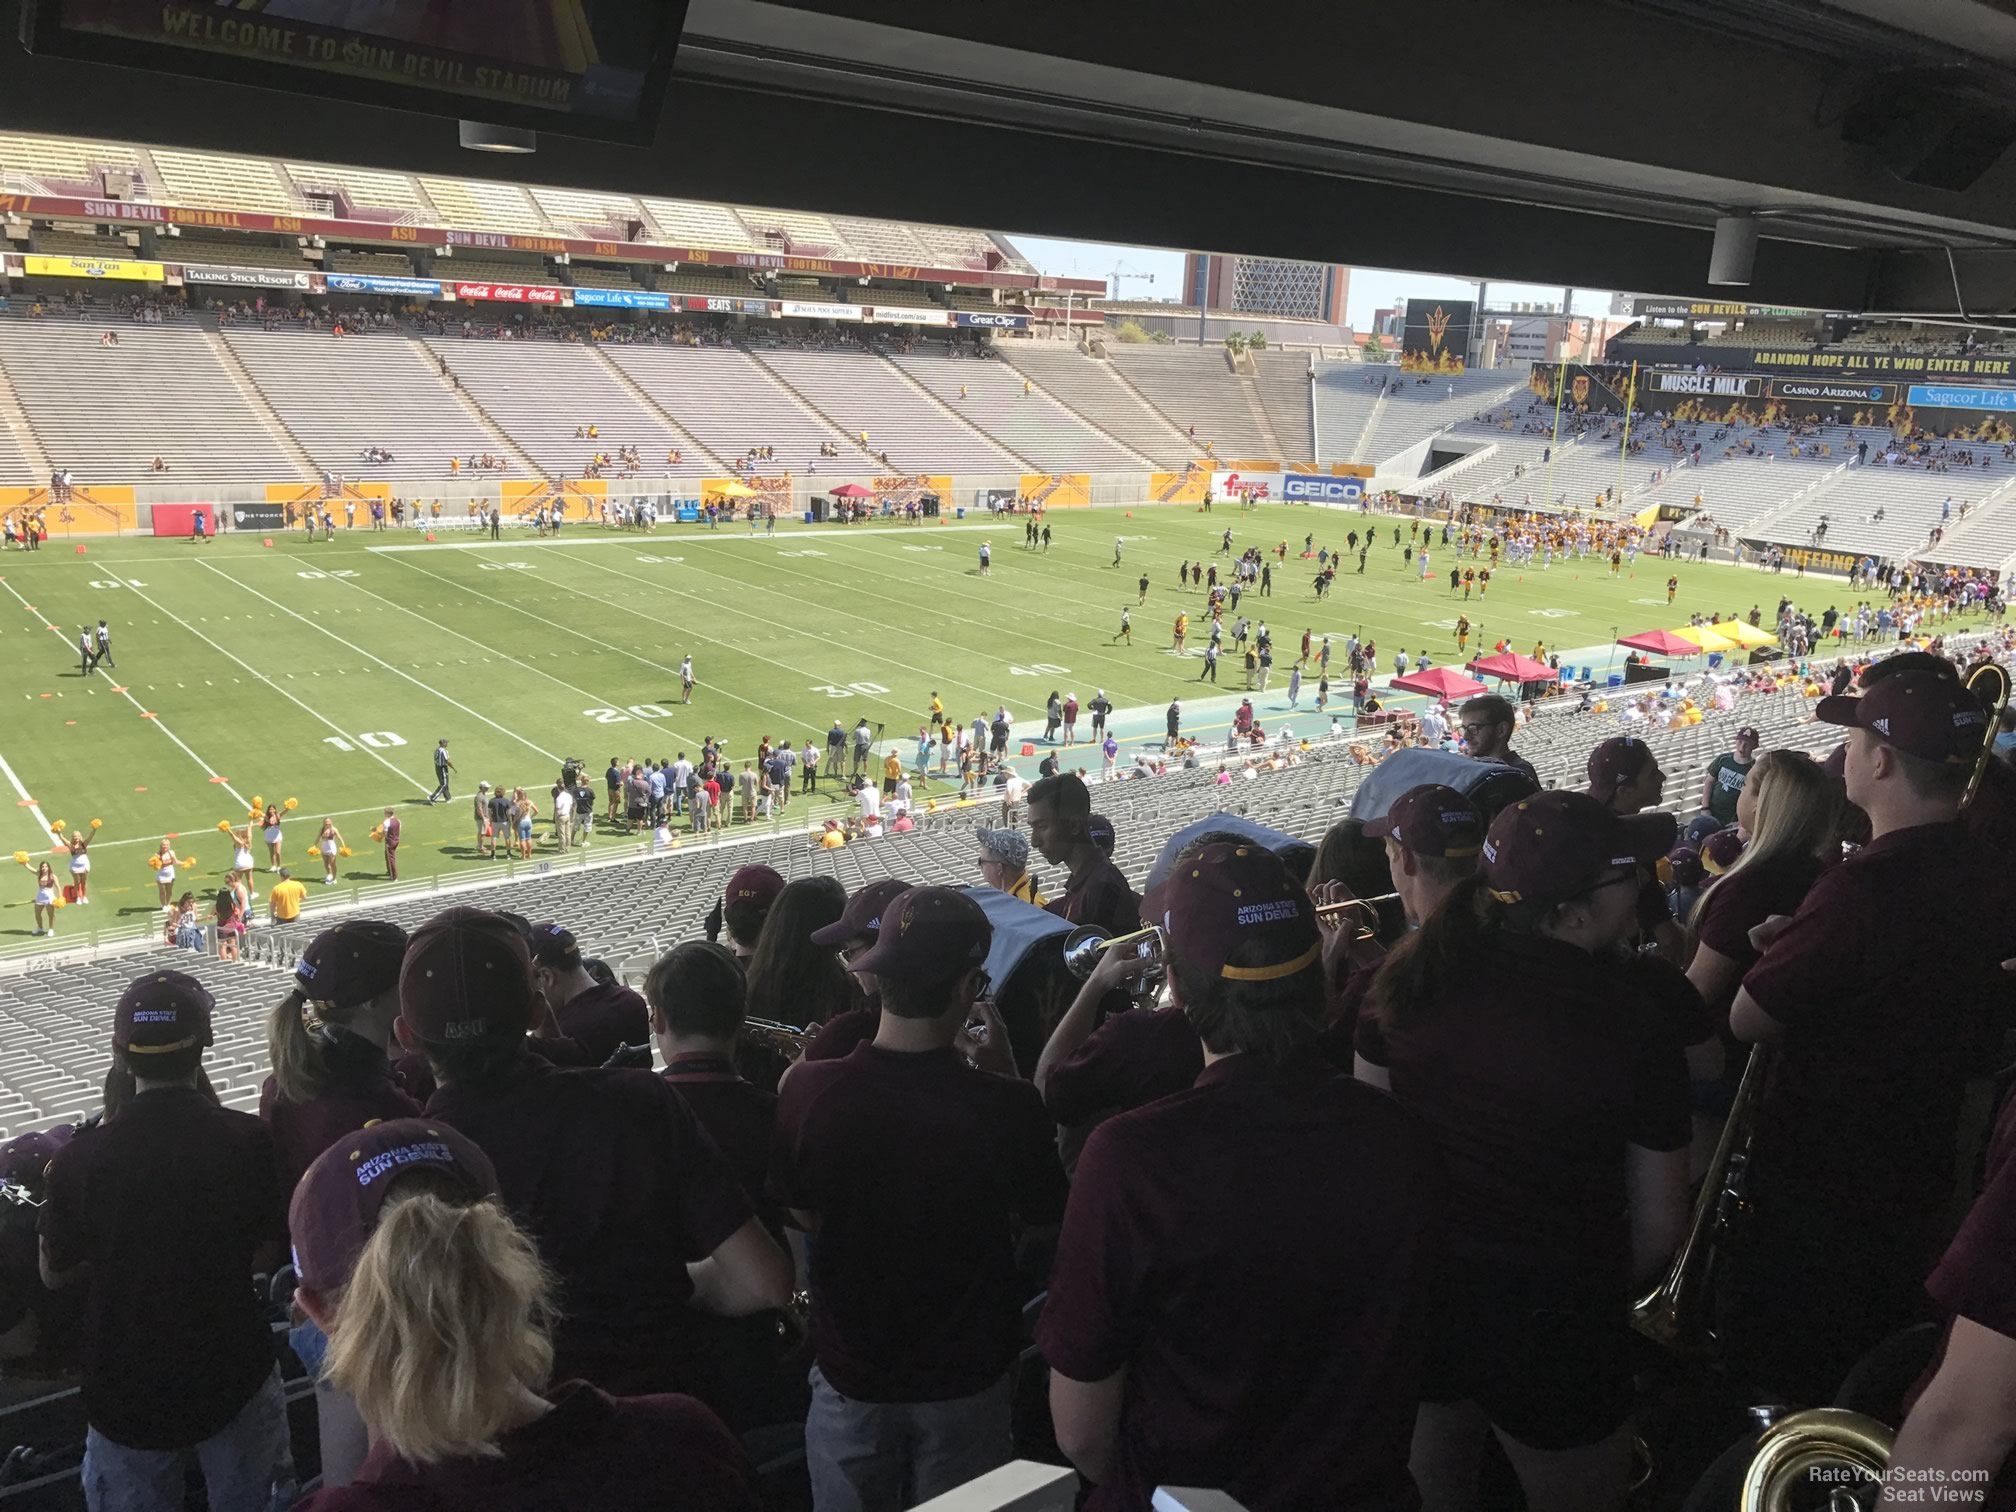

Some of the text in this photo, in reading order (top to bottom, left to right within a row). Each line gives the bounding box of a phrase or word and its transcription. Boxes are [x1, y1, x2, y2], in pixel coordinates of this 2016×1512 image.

[163, 8, 296, 53] WELCOME
[307, 35, 336, 60] TO
[343, 40, 395, 69] SUN
[403, 53, 464, 83] DEVIL
[475, 66, 570, 101] STADIUM
[84, 202, 240, 227] SUN DEVIL FOOTBALL
[273, 217, 301, 231] ASU
[391, 227, 417, 241] ASU
[446, 231, 471, 245] SUN
[475, 233, 508, 248] DEVIL
[595, 243, 617, 255] ASU
[688, 250, 709, 262] ASU
[736, 254, 833, 272] SUN DEVIL FOOTBALL
[187, 269, 293, 285] TALKING STICK RESORT
[339, 279, 361, 289] Ford
[575, 291, 604, 303] Sagicor
[607, 292, 622, 303] Life
[876, 312, 926, 321] midfirst.com/asu
[1646, 305, 1667, 313] Listen
[1677, 306, 1688, 314] the
[1690, 304, 1711, 314] SUN
[1713, 304, 1748, 315] DEVILS
[969, 314, 1017, 327] Great Clips
[1754, 352, 2011, 374] ABANDON HOPE ALL YE WHO ENTER HERE
[1660, 375, 1747, 395] MUSCLE MILK
[1783, 384, 1867, 398] CASINO ARIZONA
[1926, 389, 2008, 406] Sagicor Life
[1286, 480, 1360, 500] GEICO
[1008, 663, 1072, 677] 40
[808, 682, 890, 698] 30
[582, 704, 673, 724] 20
[323, 731, 408, 752] 10
[538, 862, 549, 871] 10
[1237, 900, 1296, 915] ARIZONA STATE
[1237, 907, 1299, 925] SUN DEVILS
[133, 1015, 149, 1023] SUN
[445, 1017, 486, 1039] ASU
[356, 1143, 448, 1177] ARIZONA STATE
[359, 1151, 453, 1186] SUN DEVILS
